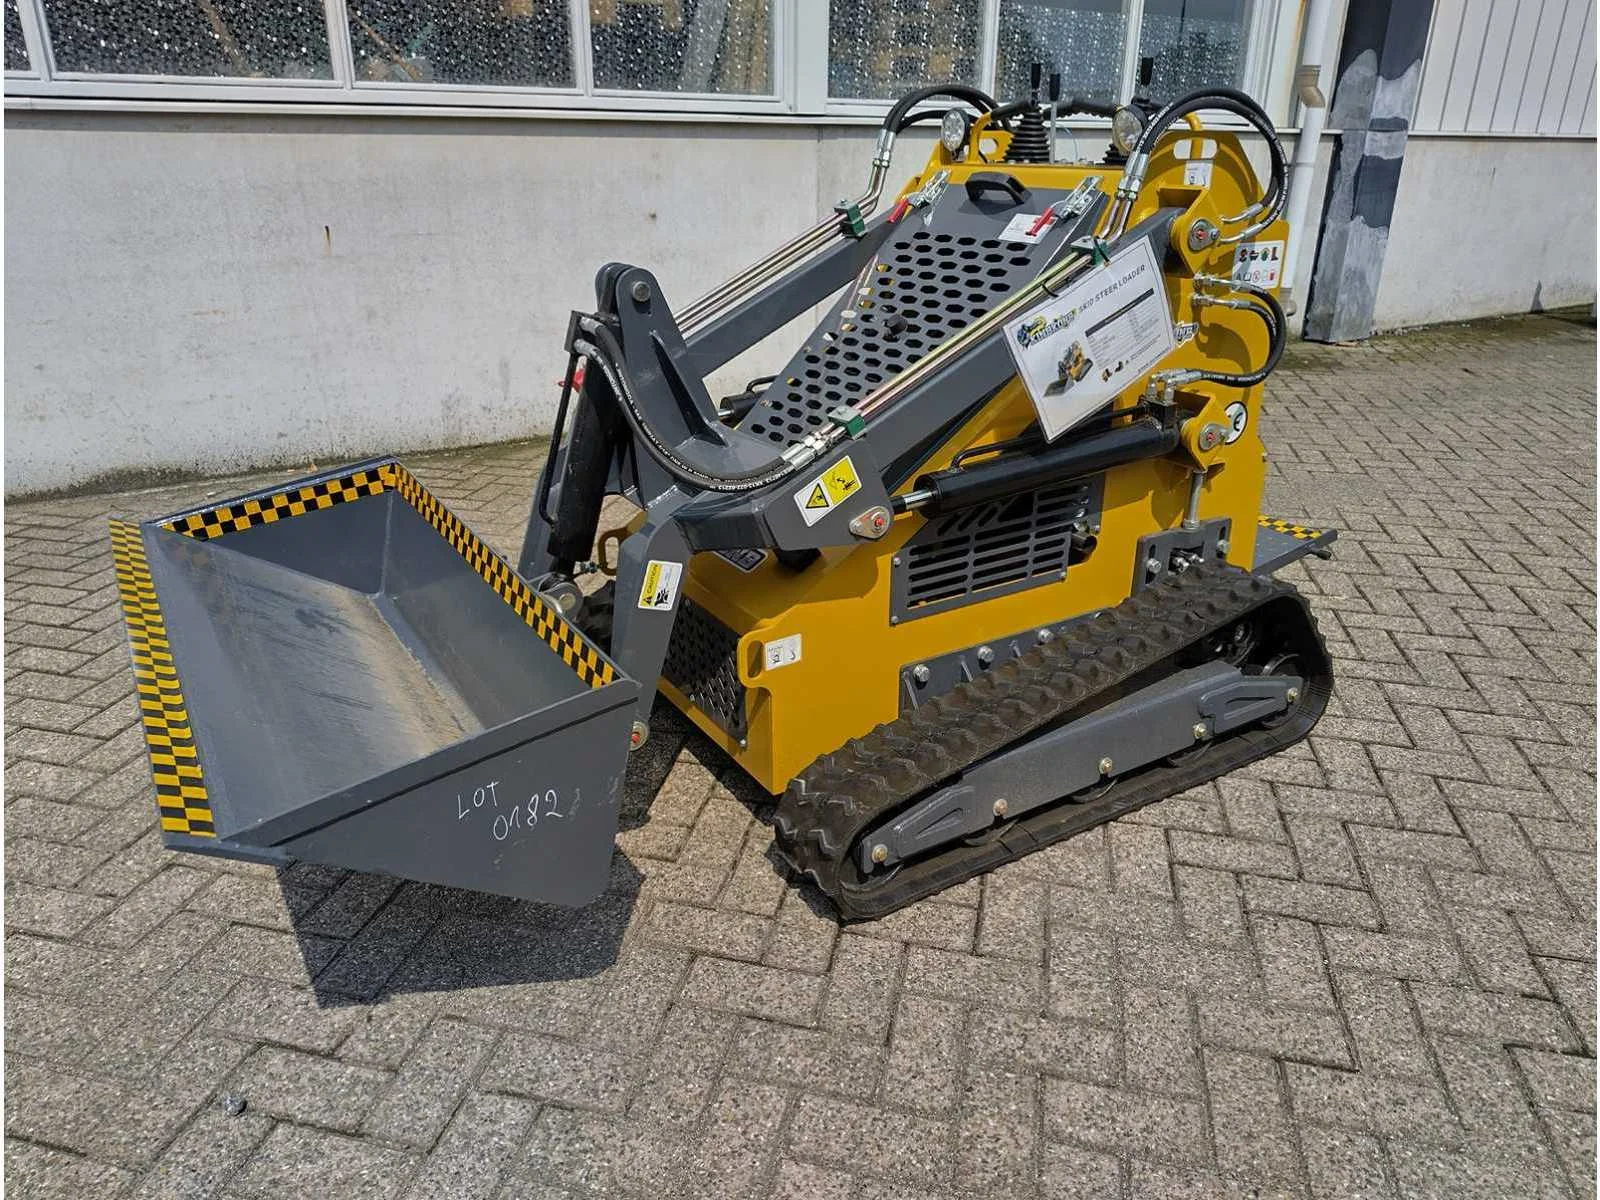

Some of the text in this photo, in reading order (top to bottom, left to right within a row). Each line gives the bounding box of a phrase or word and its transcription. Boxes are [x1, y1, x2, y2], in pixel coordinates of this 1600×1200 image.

[1096, 283, 1119, 301] STEER
[1119, 264, 1146, 287] LOADER
[646, 563, 659, 594] CAUTION
[458, 781, 500, 819] LOT
[493, 789, 563, 841] 0182
